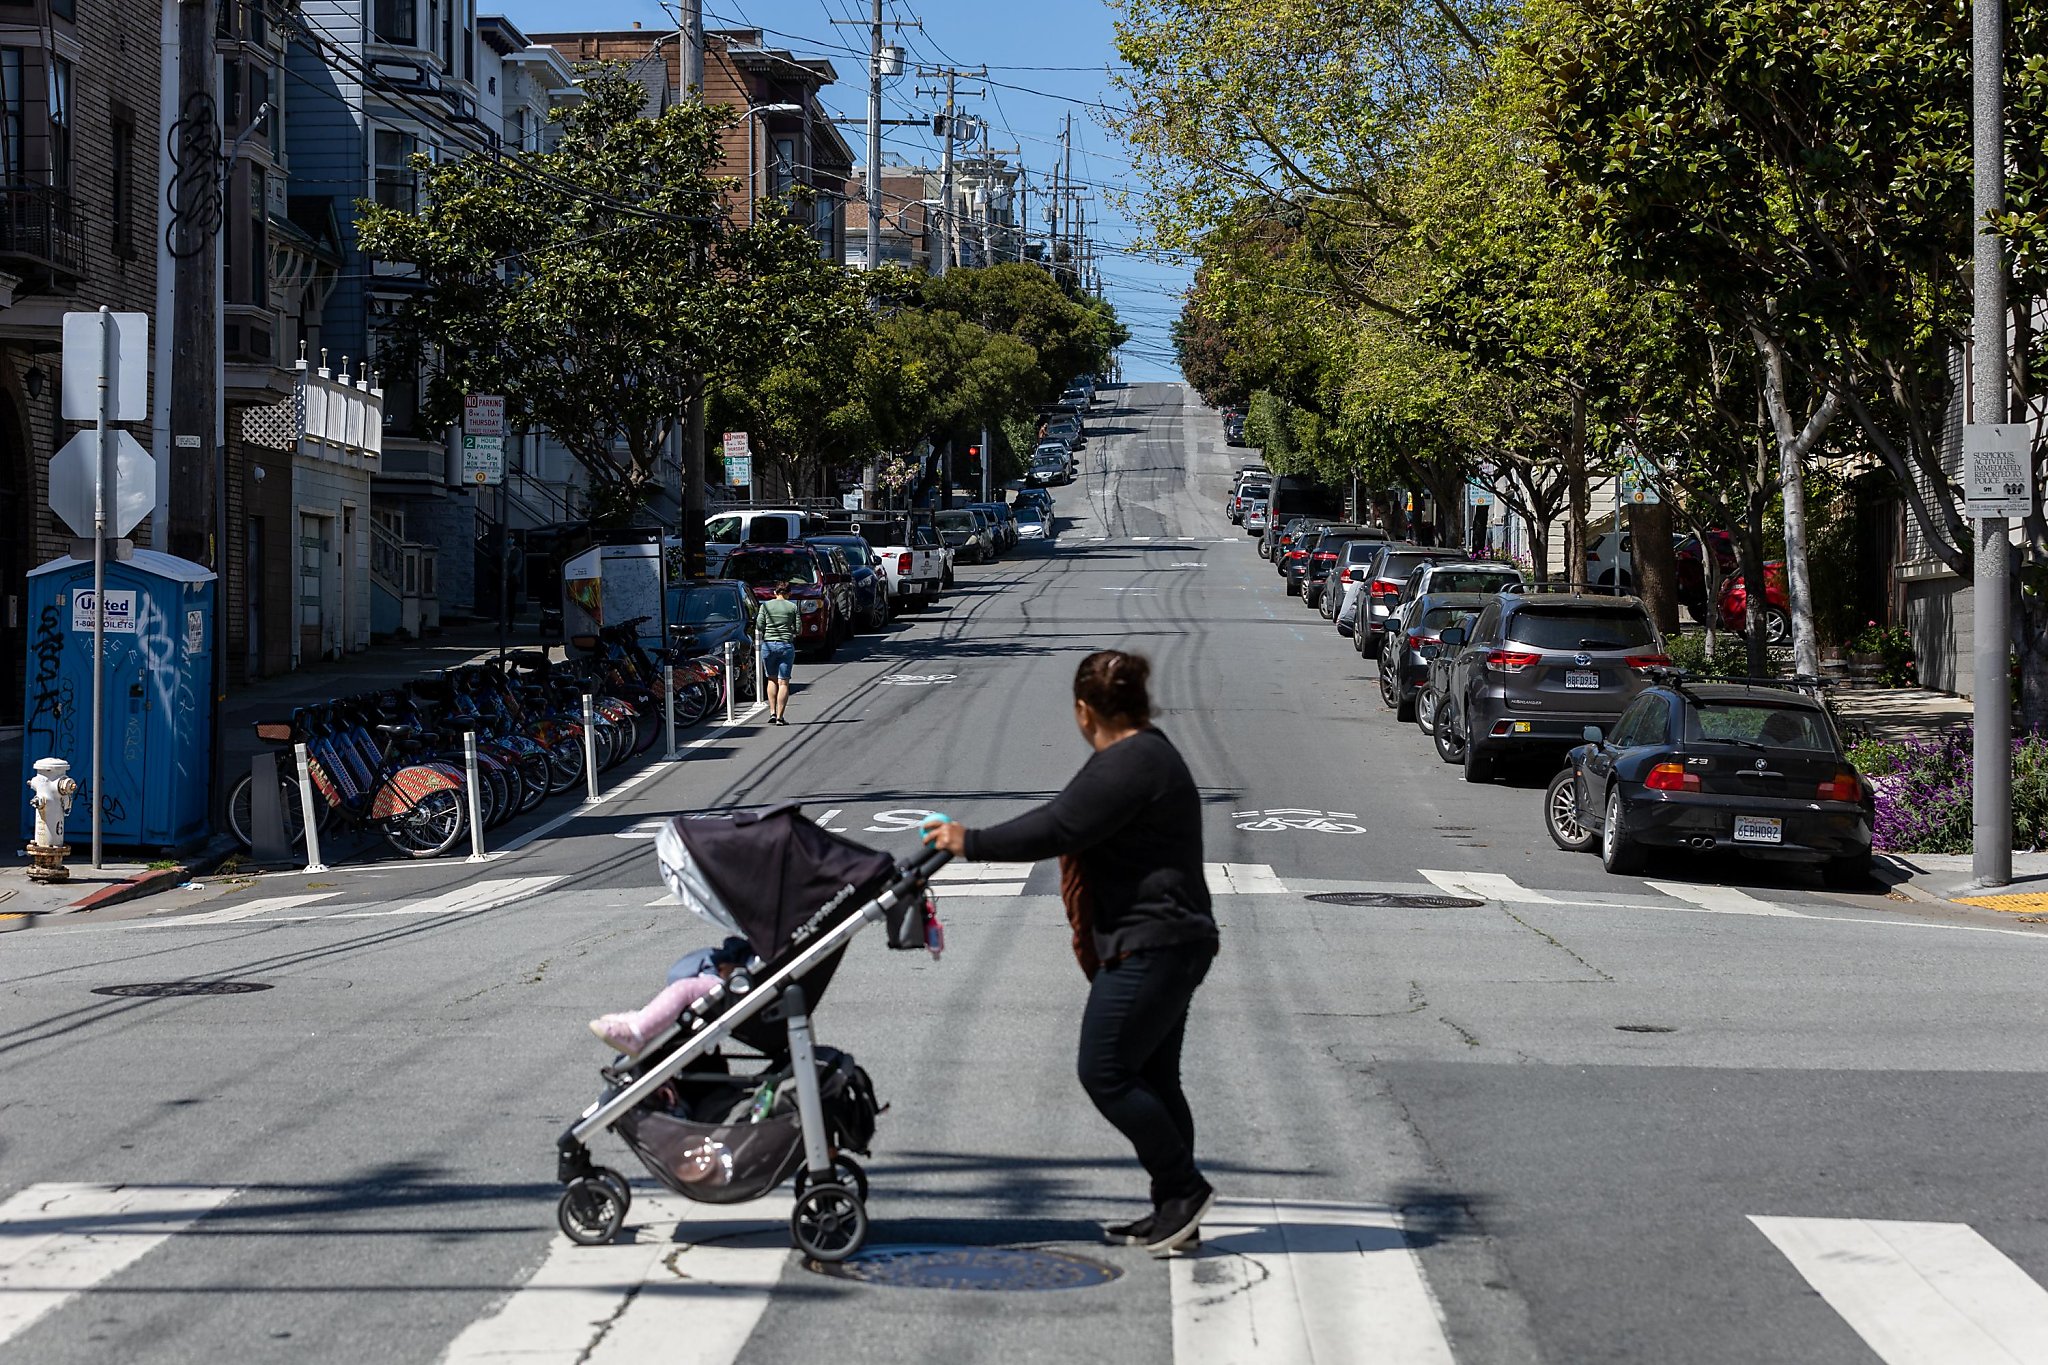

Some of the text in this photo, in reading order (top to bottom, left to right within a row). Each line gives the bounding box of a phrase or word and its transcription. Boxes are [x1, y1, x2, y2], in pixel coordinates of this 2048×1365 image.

[466, 396, 502, 408] NO PARKING
[470, 418, 499, 427] THURSDAY
[465, 437, 474, 448] 2
[1567, 675, 1598, 685] 8BFD915
[1687, 757, 1709, 765] Z3
[1737, 824, 1779, 839] 6EBH082
